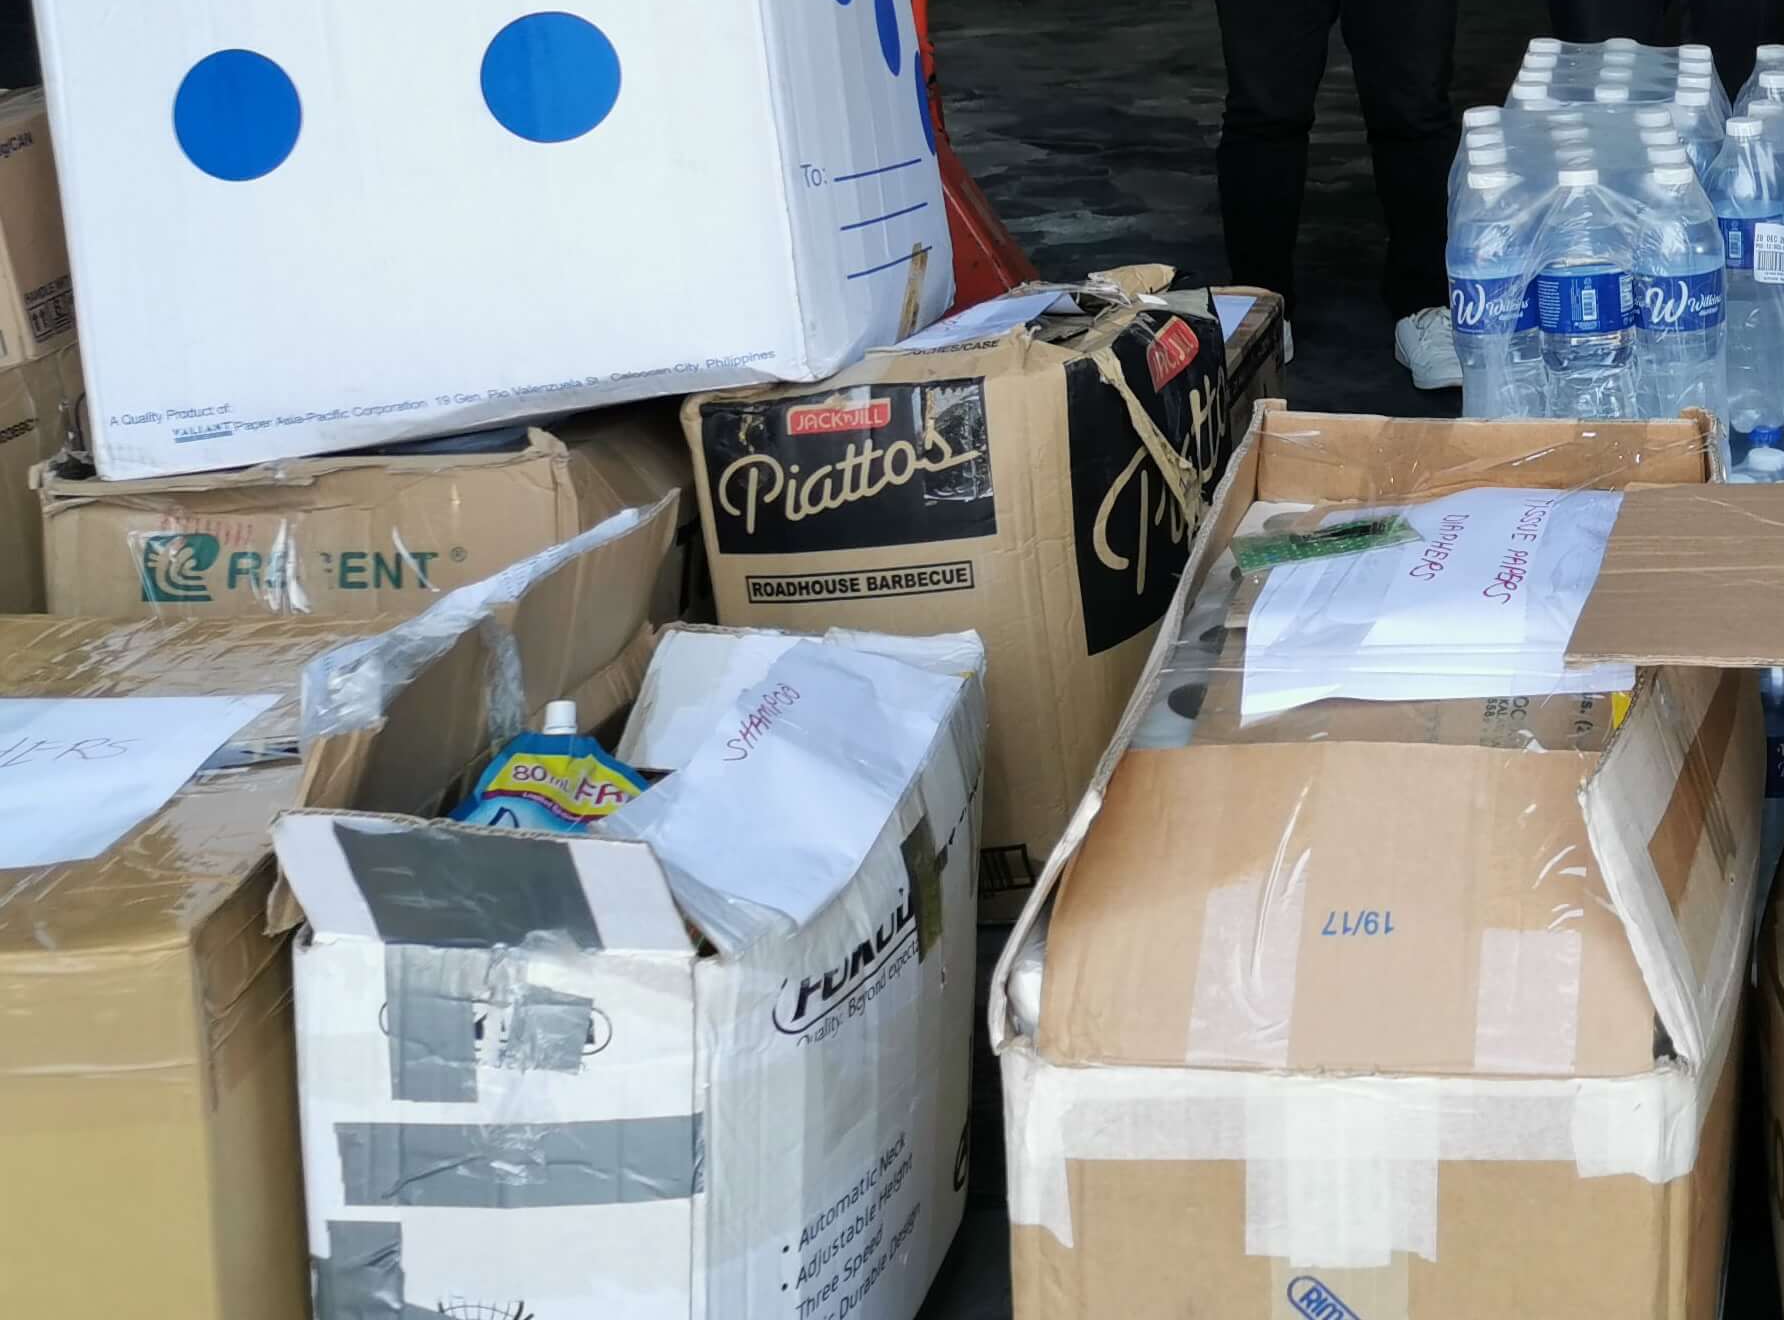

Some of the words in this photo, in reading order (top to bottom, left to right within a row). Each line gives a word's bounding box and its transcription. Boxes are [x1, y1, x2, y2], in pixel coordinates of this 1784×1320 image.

[800, 163, 828, 189] To:
[706, 349, 776, 370] Philippines
[110, 415, 119, 426] A
[121, 410, 163, 426] Quality
[167, 405, 213, 421] Product
[719, 430, 982, 535] Piattos
[1511, 497, 1554, 543] TISSUE
[751, 575, 861, 601] ROADHOUSE
[866, 566, 970, 592] BARBECUE
[722, 682, 801, 762] SHAMPOO
[511, 765, 548, 782] 80
[1320, 910, 1396, 937] 19/17
[847, 968, 887, 1018] Beyond
[797, 1166, 879, 1253] Automatic
[879, 1131, 907, 1177] Neck
[795, 1203, 877, 1290] Adjustable
[878, 1152, 913, 1211] Height
[796, 1274, 840, 1320] Three
[843, 1223, 884, 1282] Speed
[838, 1253, 888, 1320] Durable
